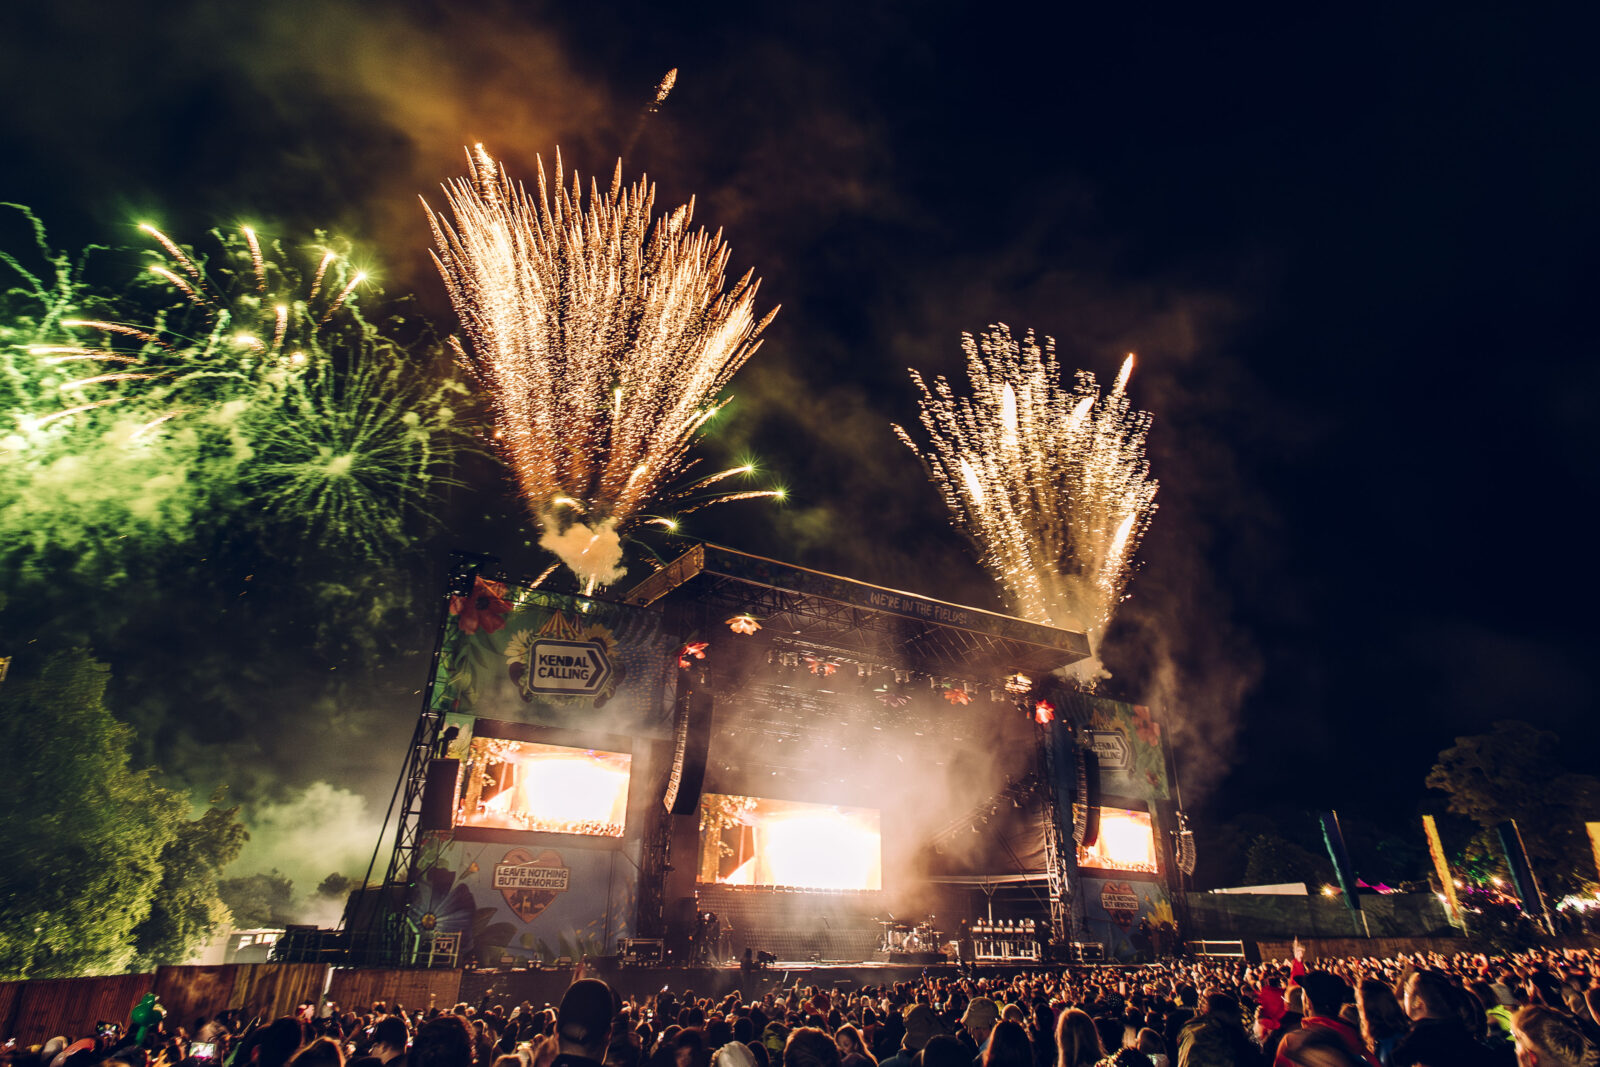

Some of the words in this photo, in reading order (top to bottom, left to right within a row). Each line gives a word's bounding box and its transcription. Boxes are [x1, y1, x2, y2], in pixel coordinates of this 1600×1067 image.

[902, 599, 914, 612] IN
[914, 601, 933, 617] THE
[538, 654, 590, 668] KENDAL
[538, 667, 589, 680] CALLING
[497, 867, 526, 877] LEAVE
[528, 868, 568, 879] NOTHING
[498, 876, 518, 886] BUT
[519, 877, 565, 888] MEMORIES
